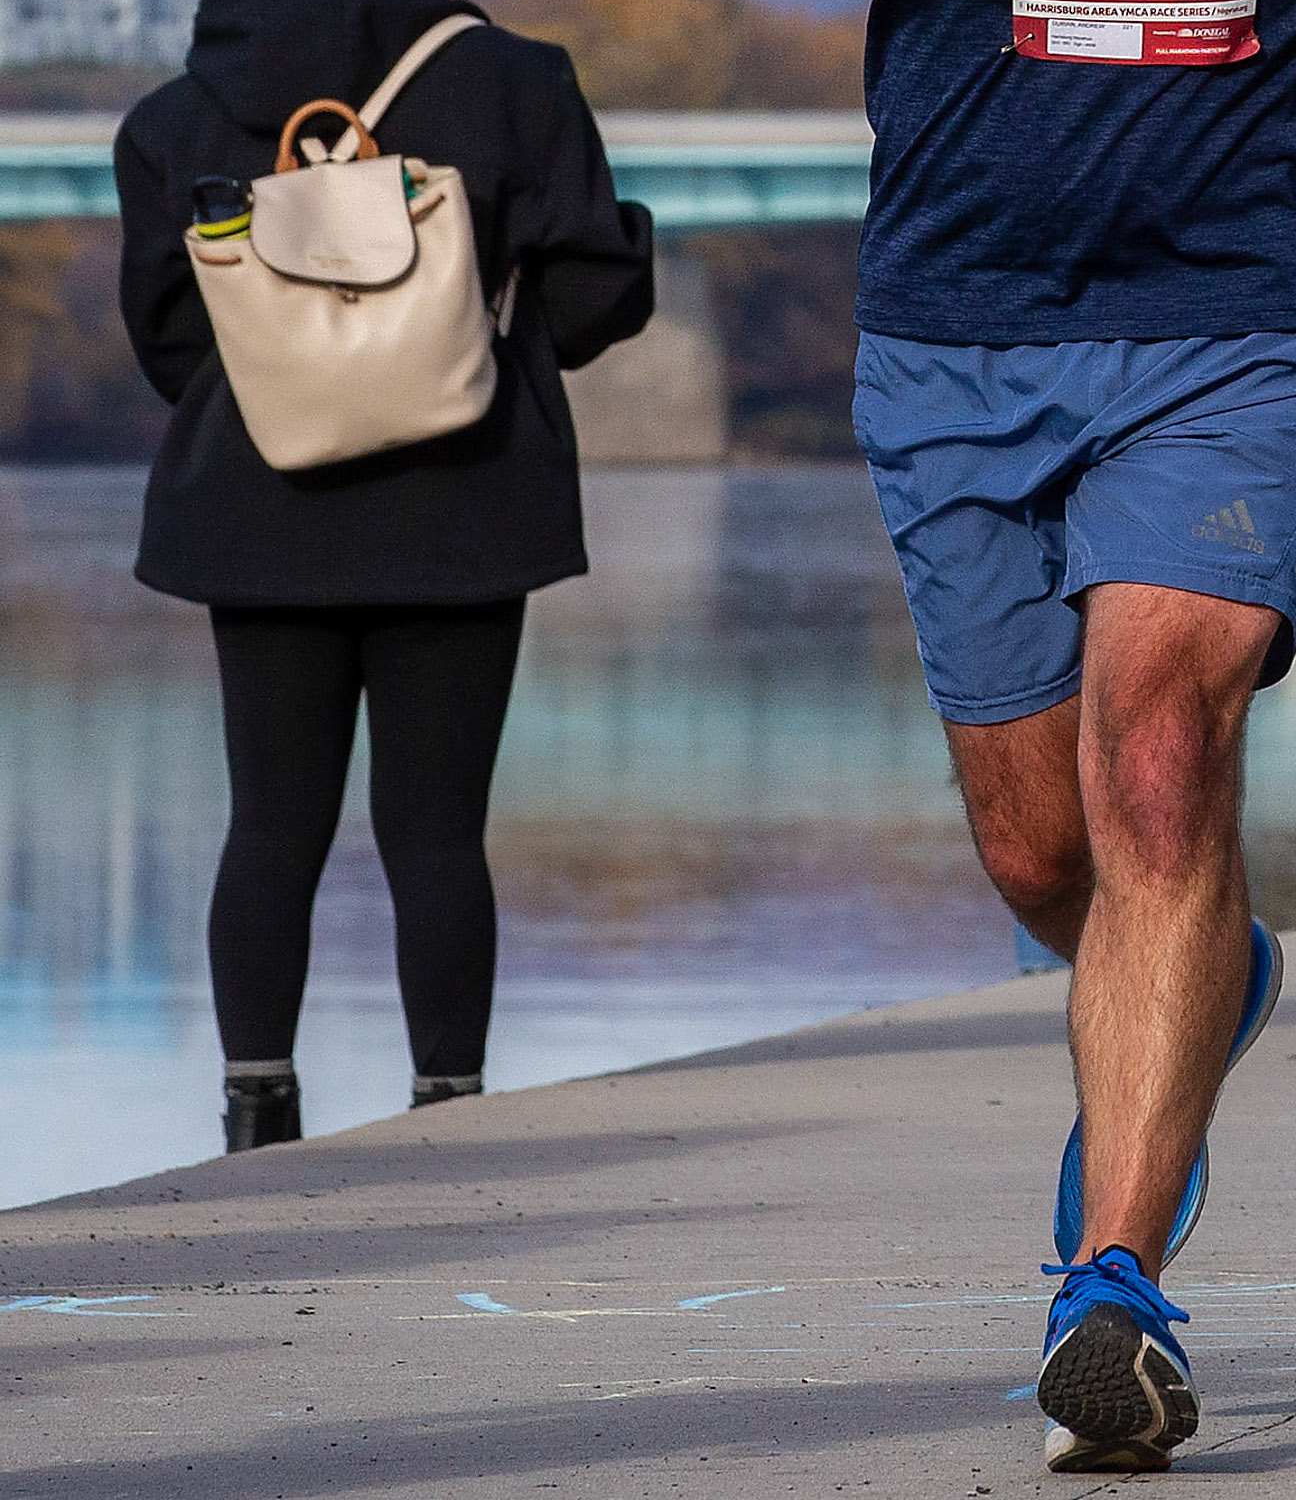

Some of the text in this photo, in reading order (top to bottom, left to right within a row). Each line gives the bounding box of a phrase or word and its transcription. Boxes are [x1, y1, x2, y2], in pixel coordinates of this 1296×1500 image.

[1026, 3, 1090, 16] HARRISBURG
[1091, 7, 1119, 16] AREA
[1119, 8, 1149, 17] YMCA
[1149, 7, 1176, 17] RACE
[1177, 7, 1211, 17] SERIES
